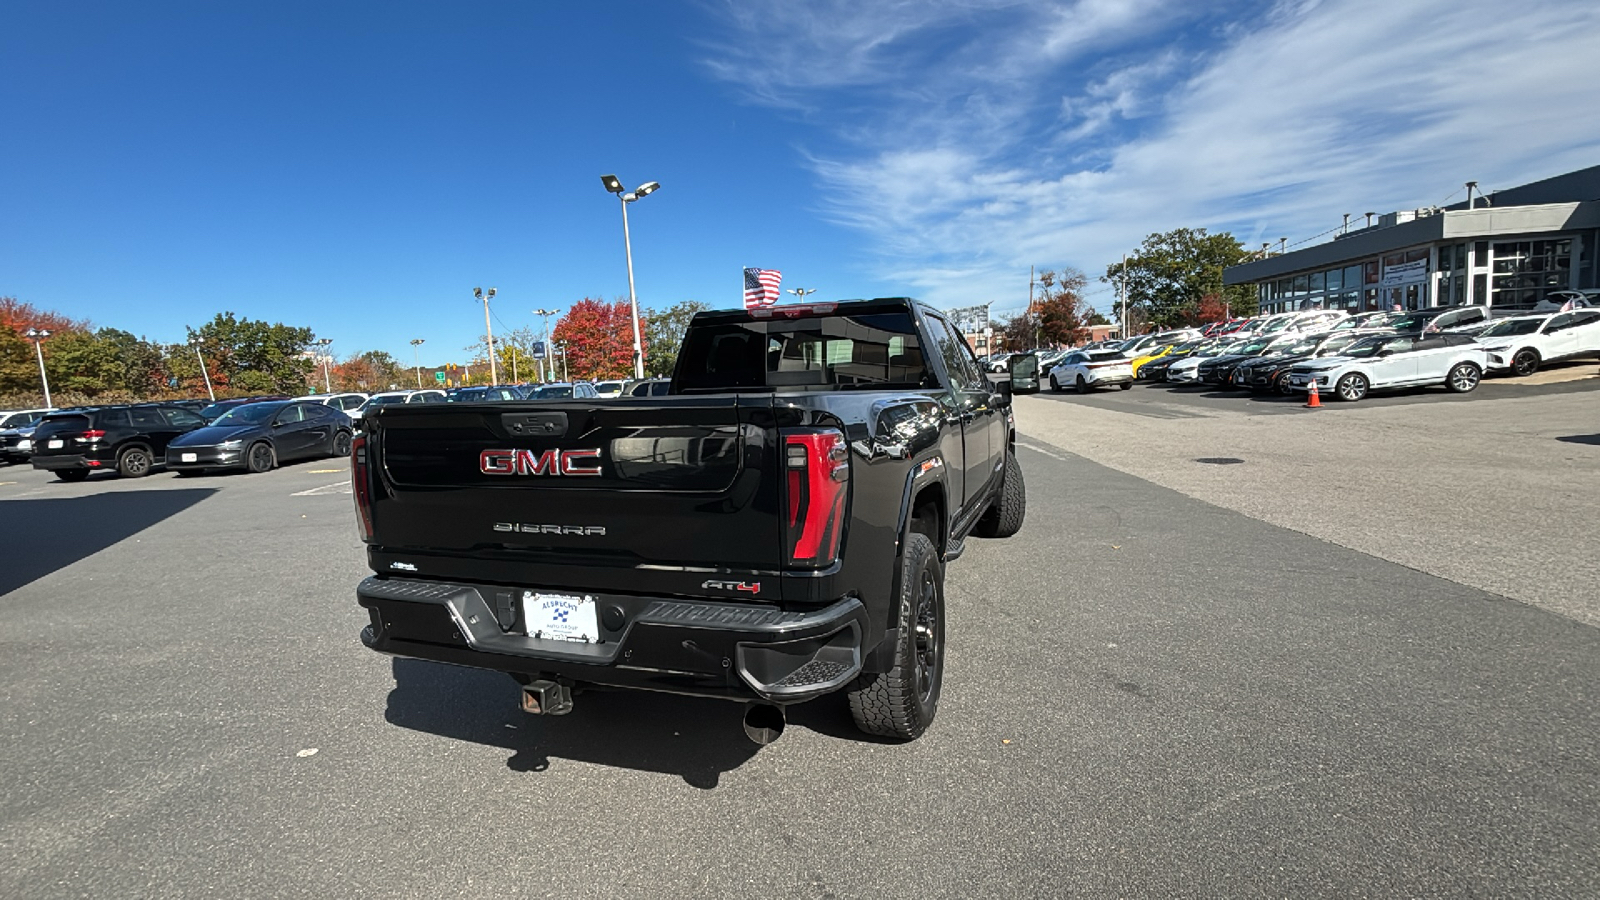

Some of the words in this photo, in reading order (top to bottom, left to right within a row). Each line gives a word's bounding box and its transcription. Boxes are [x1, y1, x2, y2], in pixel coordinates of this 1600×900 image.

[480, 448, 602, 475] GMC
[493, 522, 606, 535] SIERRA
[701, 580, 761, 594] AT4
[542, 600, 578, 612] ALBRECHT
